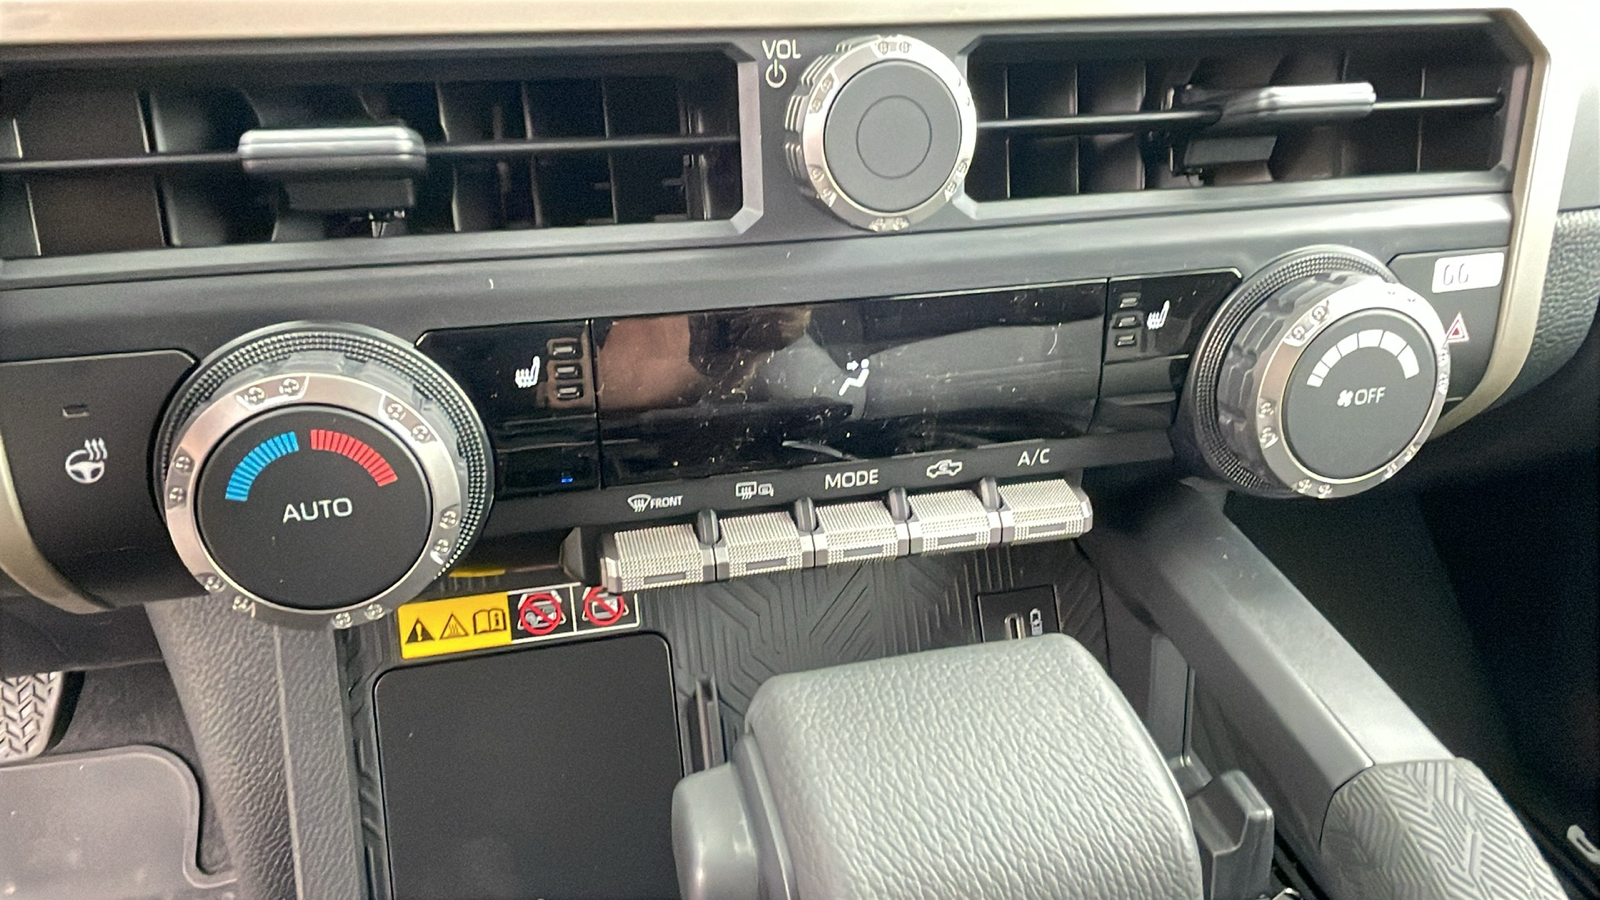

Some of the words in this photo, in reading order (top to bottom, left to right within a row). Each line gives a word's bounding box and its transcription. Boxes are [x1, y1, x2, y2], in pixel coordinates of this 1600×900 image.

[762, 39, 801, 59] VOL
[1354, 386, 1386, 405] OFF
[1018, 448, 1051, 467] A/C
[824, 469, 879, 490] MODE
[282, 497, 353, 524] AUTO
[650, 494, 683, 509] FRONT
